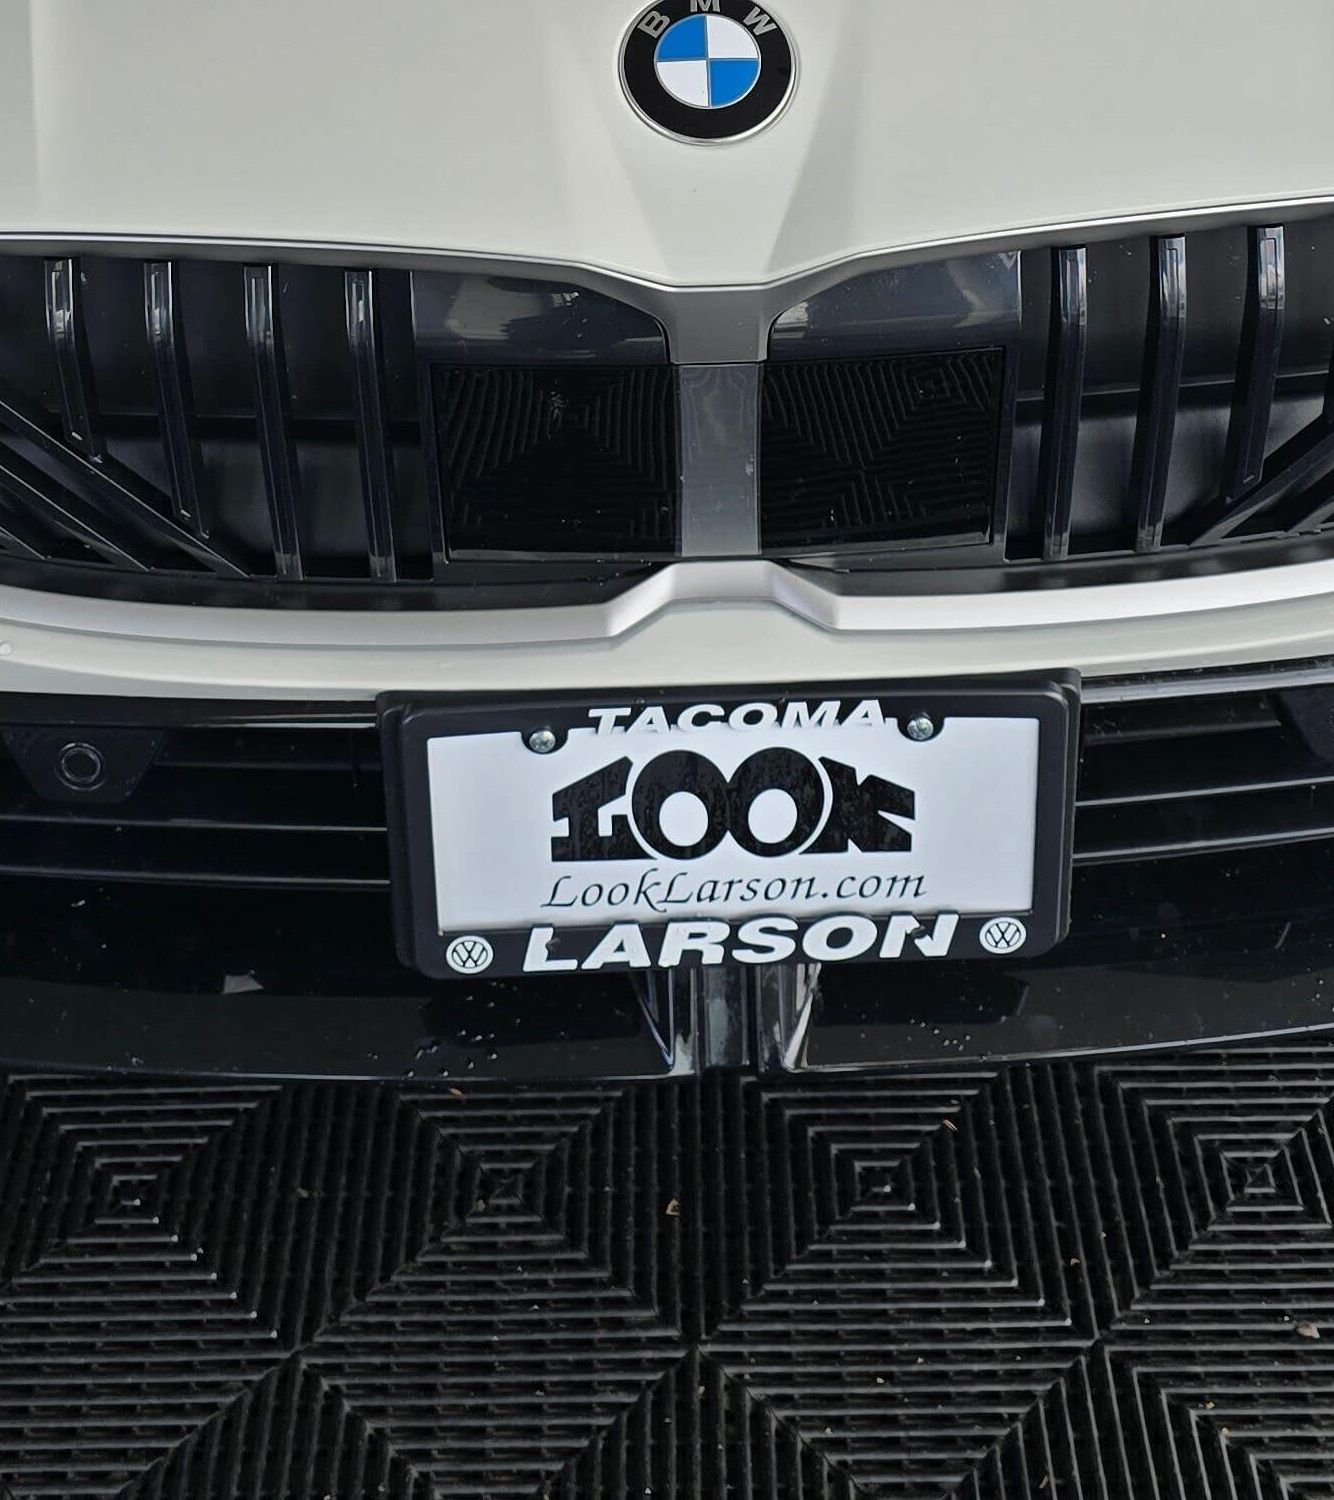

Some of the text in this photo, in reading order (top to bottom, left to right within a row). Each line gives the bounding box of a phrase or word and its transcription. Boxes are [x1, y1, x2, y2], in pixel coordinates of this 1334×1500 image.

[587, 698, 888, 736] TACOMA
[551, 746, 915, 863] LOOK
[540, 866, 927, 912] LookLarson.com
[522, 912, 959, 972] LARSON
